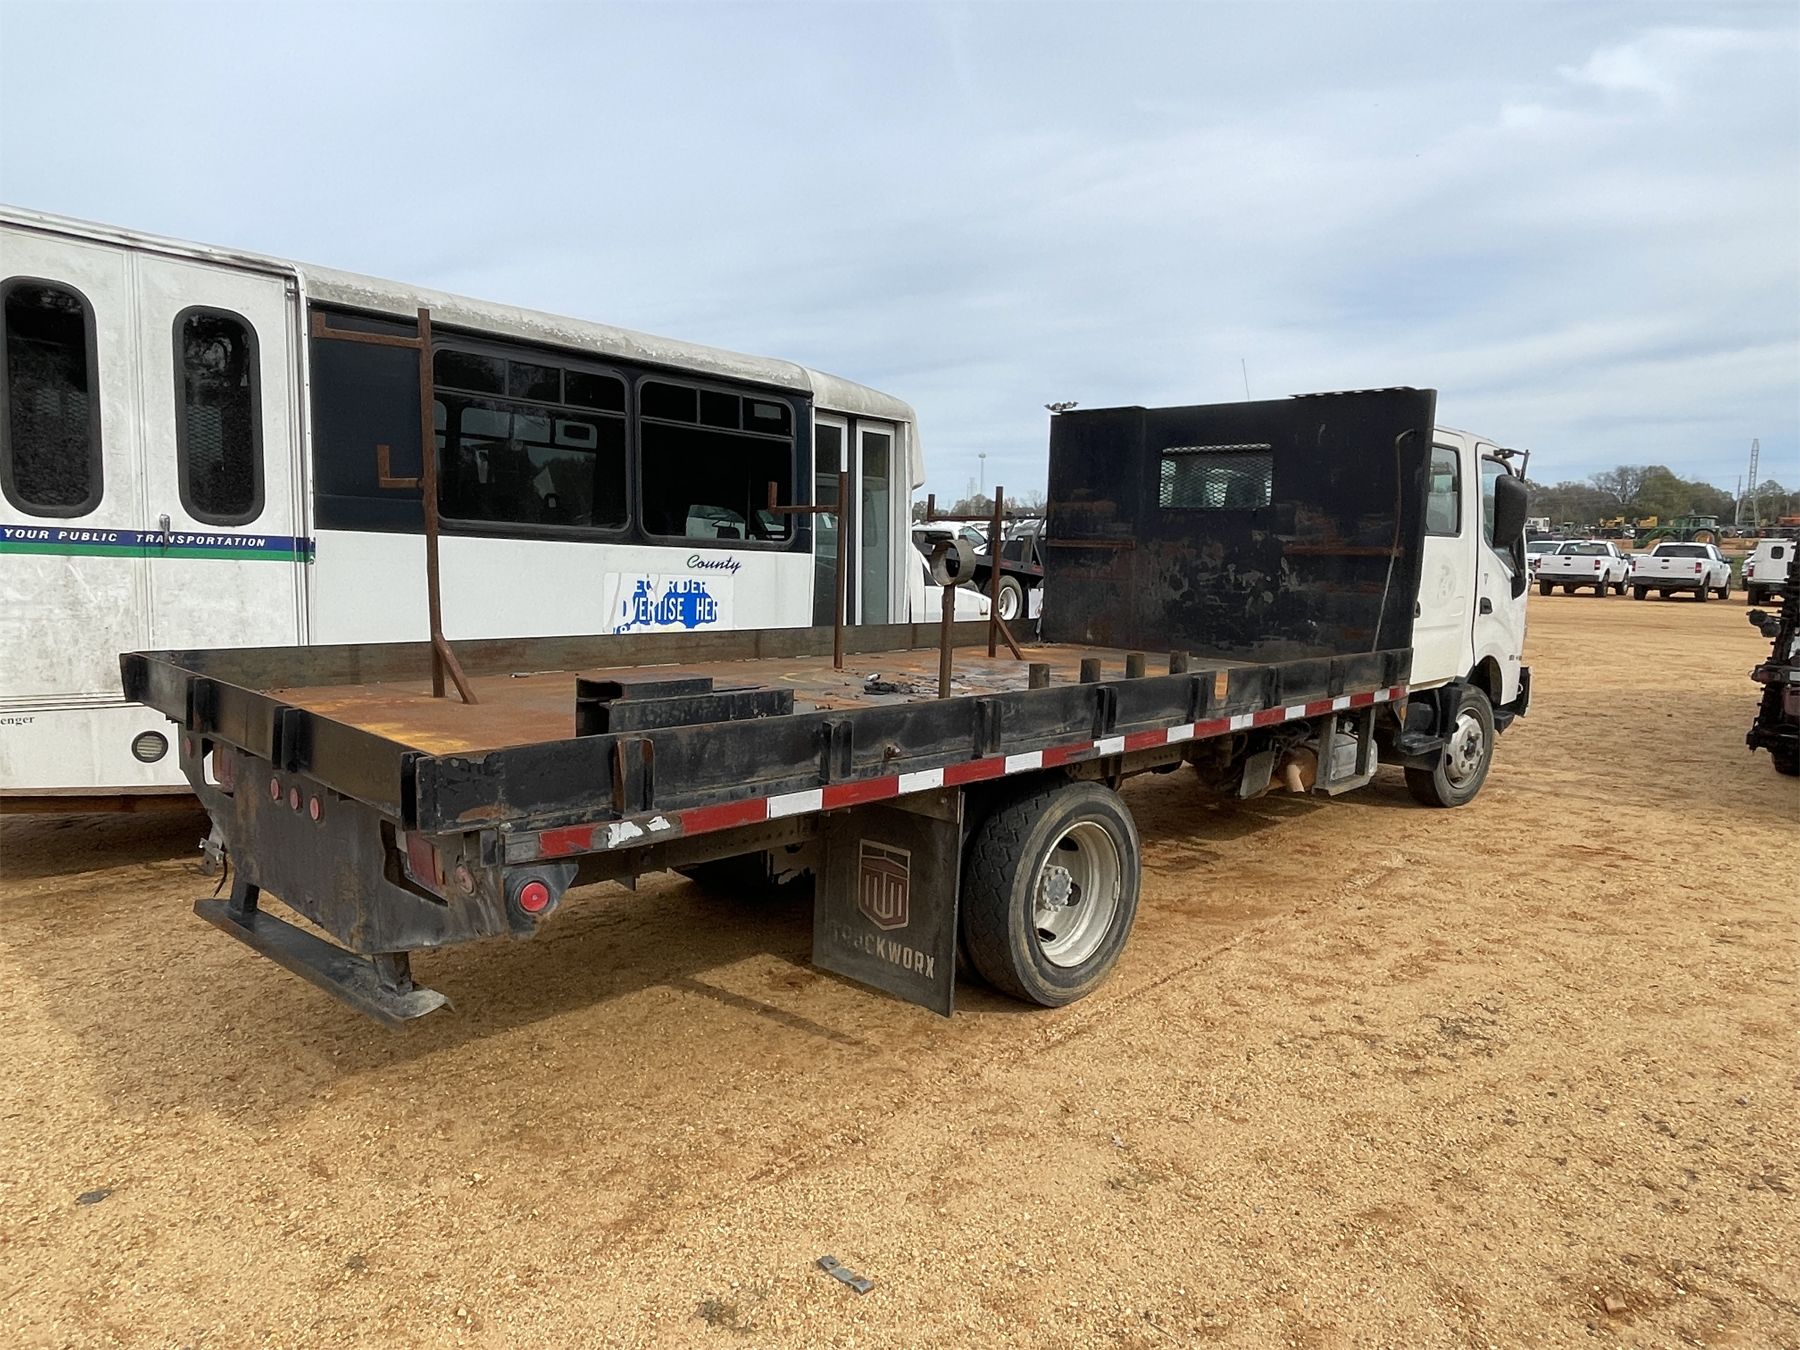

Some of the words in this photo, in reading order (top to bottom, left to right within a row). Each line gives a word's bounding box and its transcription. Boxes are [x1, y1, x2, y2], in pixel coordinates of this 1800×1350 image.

[3, 528, 50, 540] YOUR
[58, 531, 118, 543] PUBLIC
[136, 533, 266, 547] TRANSPORTATION
[686, 554, 742, 574] County
